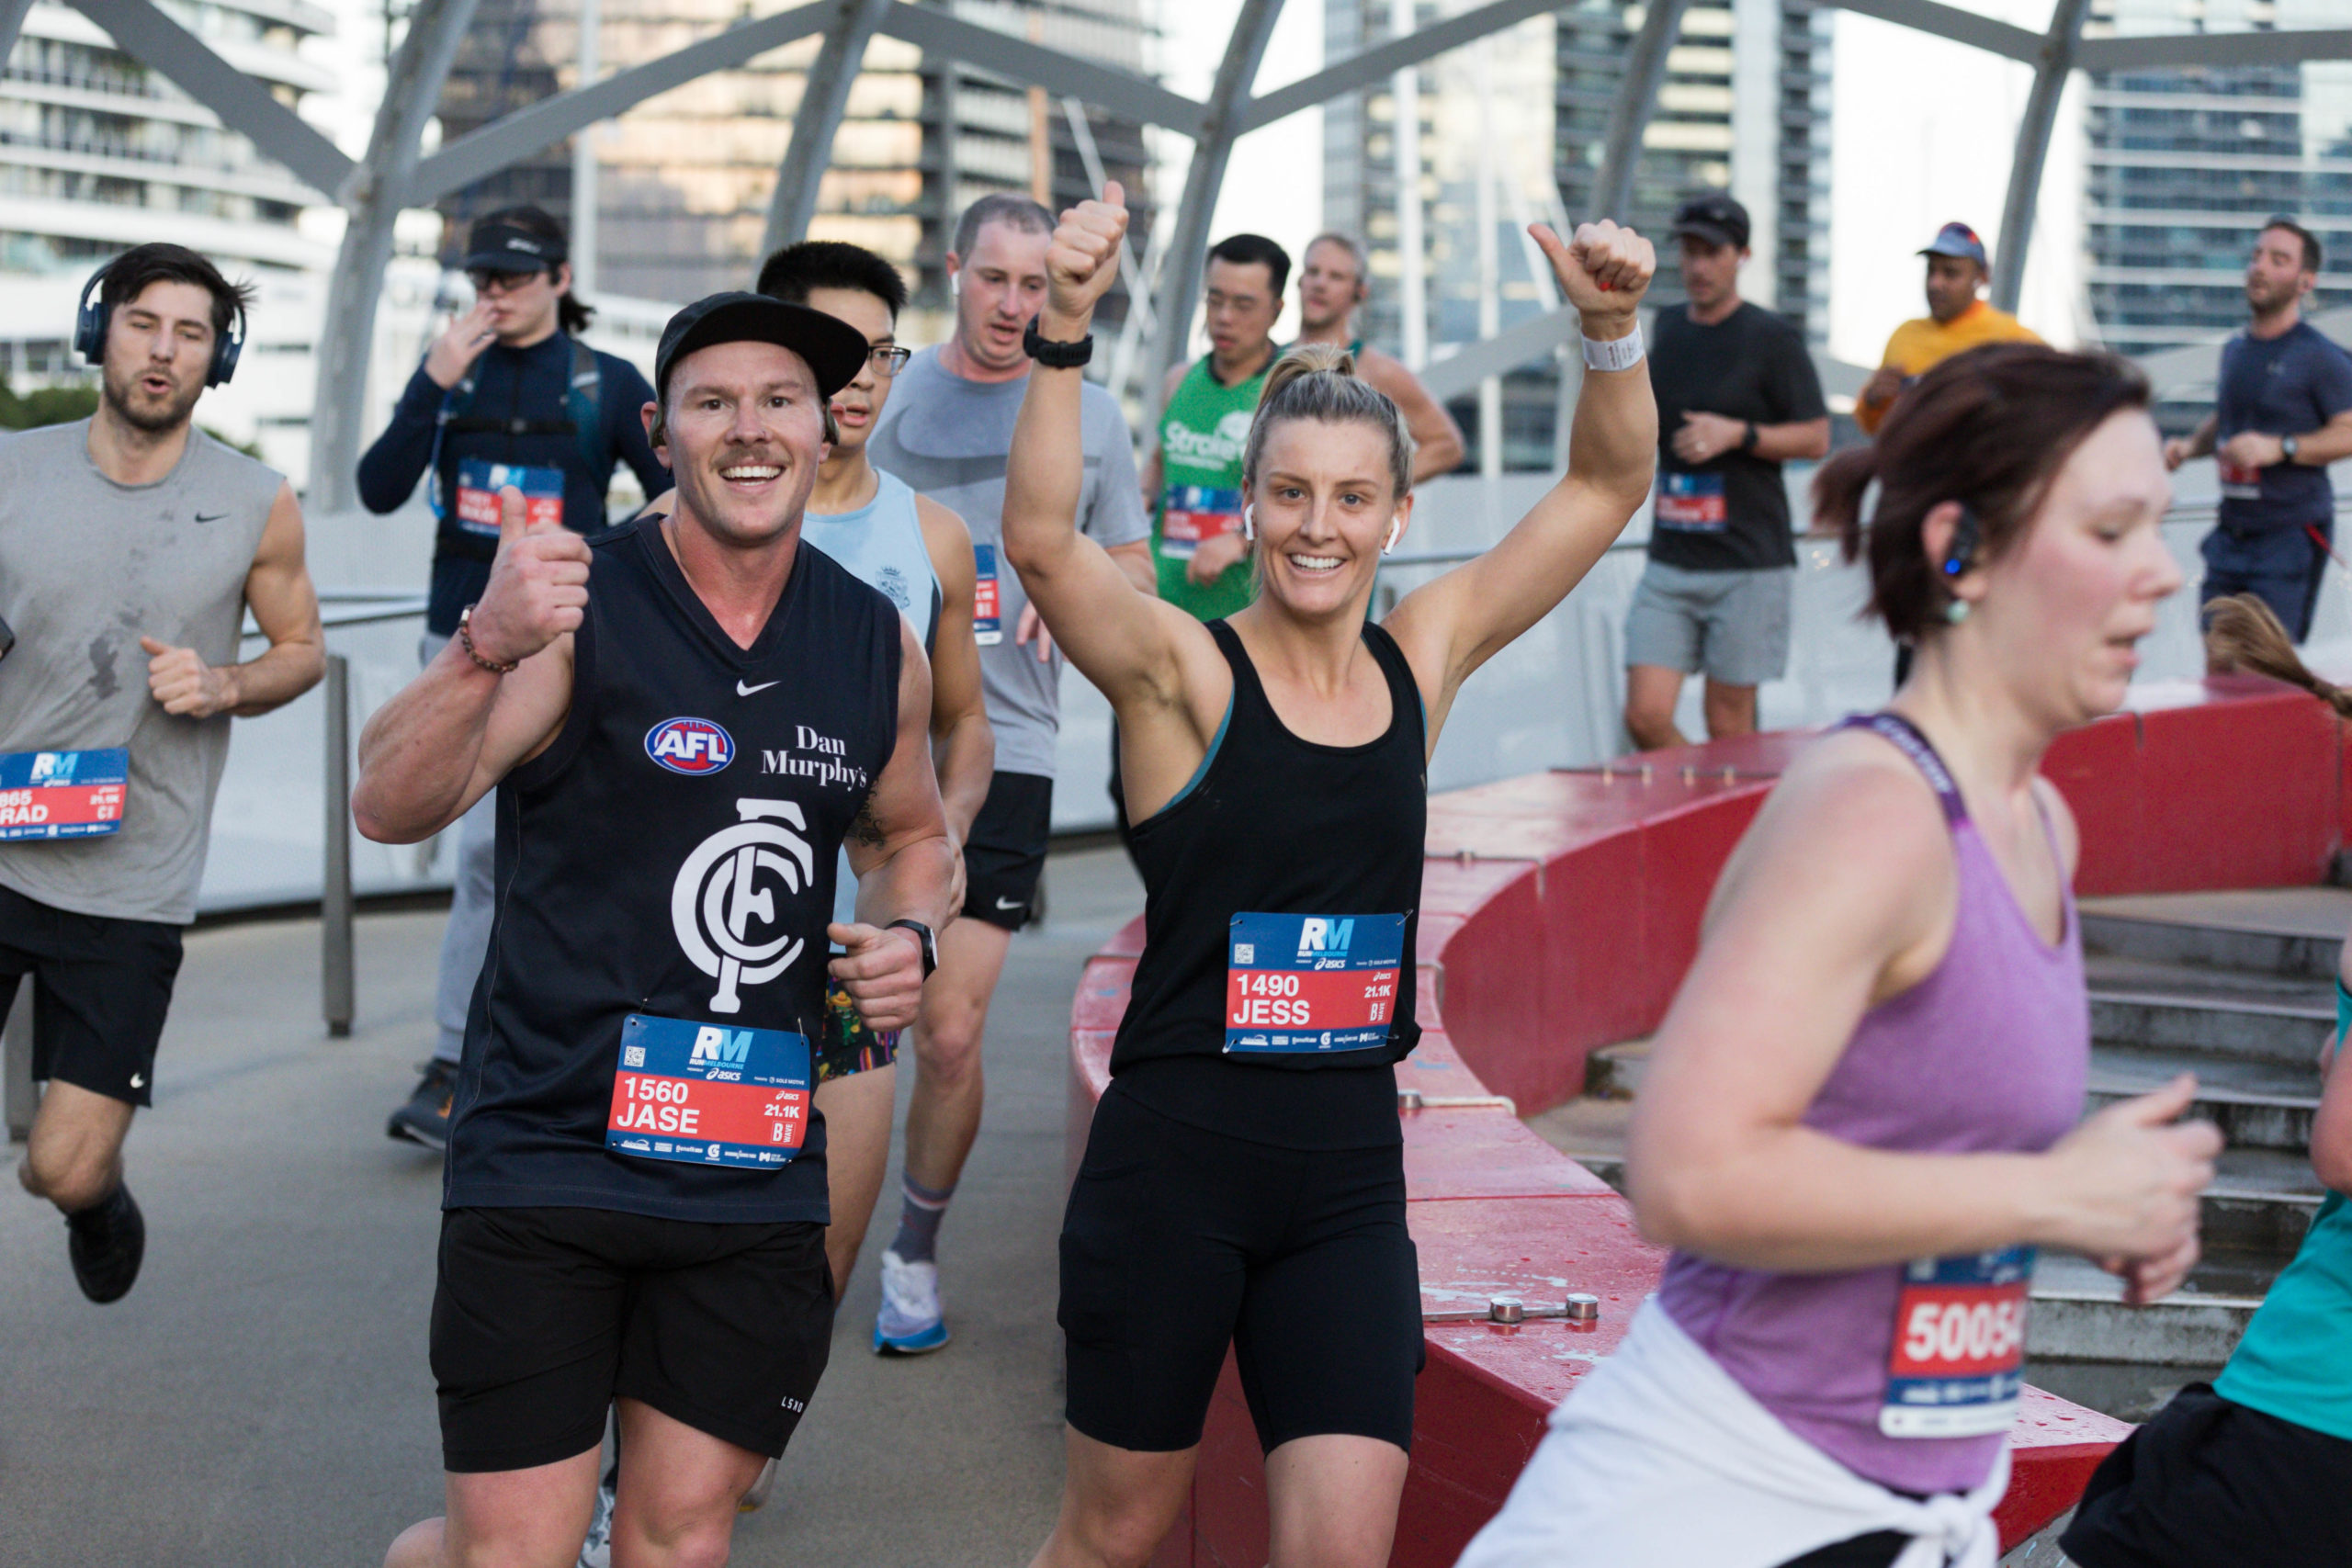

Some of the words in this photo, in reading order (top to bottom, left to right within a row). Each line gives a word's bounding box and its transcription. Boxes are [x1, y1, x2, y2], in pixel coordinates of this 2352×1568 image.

[653, 729, 728, 762] AFL
[795, 725, 847, 756] Dan
[31, 752, 79, 775] RM
[761, 750, 867, 792] Murphy's
[1298, 918, 1354, 951] RM
[1325, 960, 1346, 969] asics
[1237, 974, 1300, 997] 1490
[1364, 985, 1392, 998] 21.1K
[1233, 999, 1310, 1025] JESS
[1370, 1003, 1378, 1021] B
[691, 1026, 754, 1063] RM
[718, 1070, 741, 1081] asics
[625, 1077, 688, 1104] 1560
[616, 1102, 700, 1134] JASE
[764, 1103, 800, 1119] 21.1K
[773, 1122, 783, 1142] B
[783, 1123, 793, 1143] WAVE
